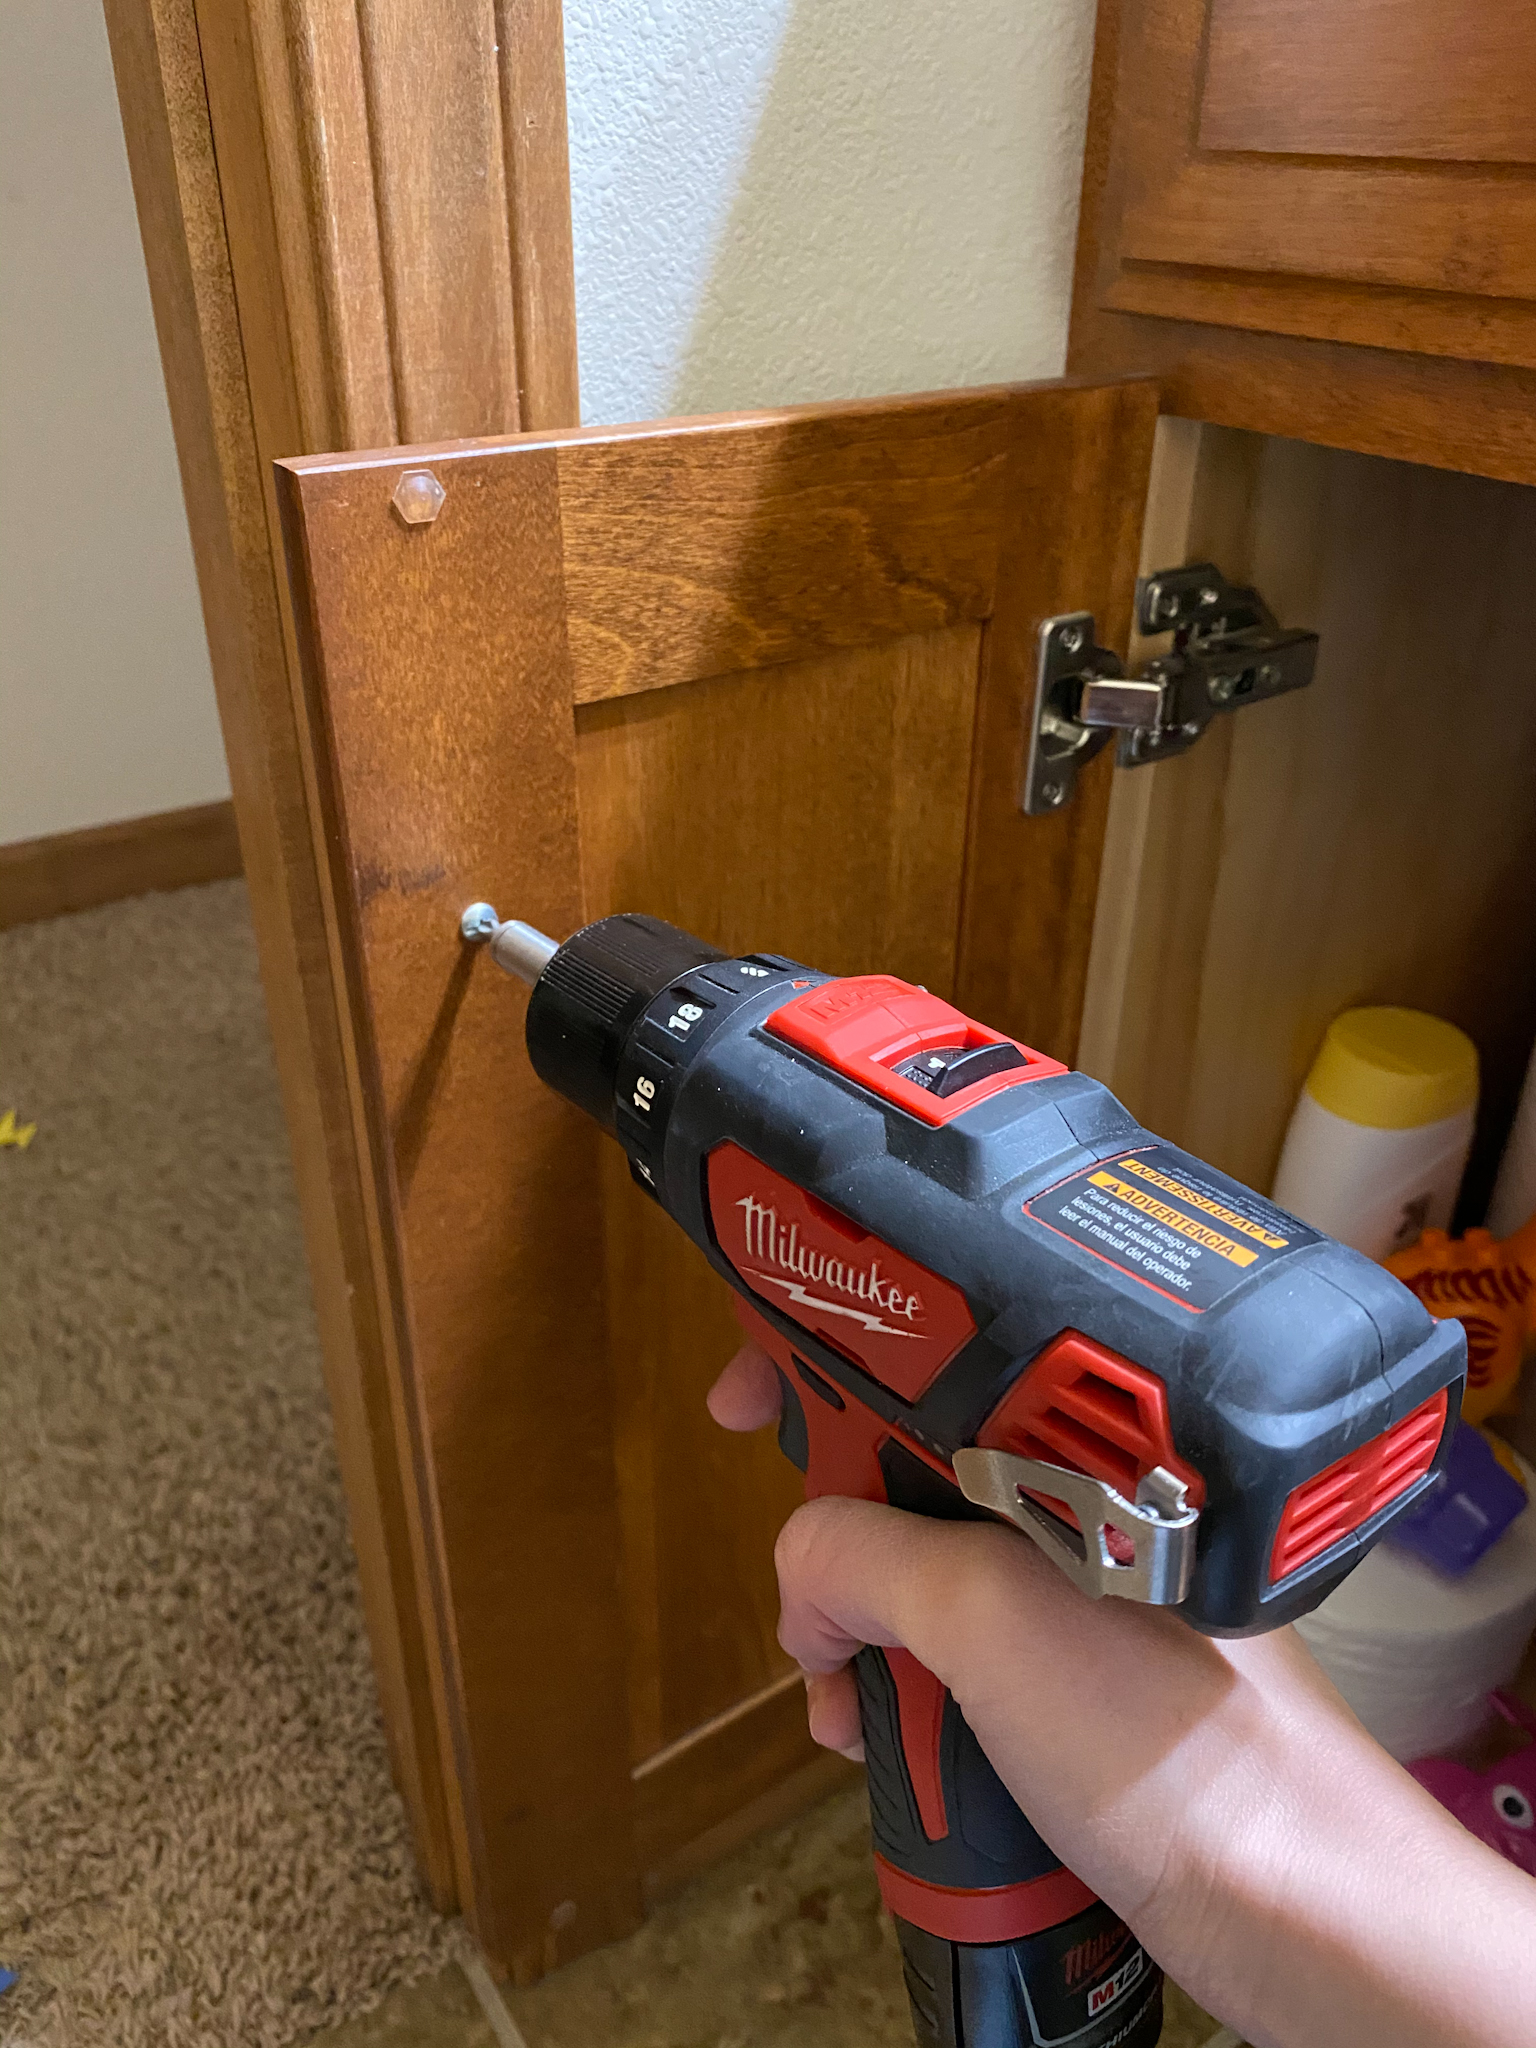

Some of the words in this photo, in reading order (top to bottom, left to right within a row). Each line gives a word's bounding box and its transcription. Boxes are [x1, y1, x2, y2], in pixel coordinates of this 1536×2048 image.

[669, 1003, 703, 1031] 18
[633, 1076, 655, 1112] 16
[1083, 1188, 1107, 1206] Para
[1107, 1199, 1145, 1225] reducir
[1143, 1217, 1153, 1231] el
[1152, 1224, 1185, 1249] riesgo
[1185, 1241, 1202, 1259] de
[1120, 1190, 1236, 1255] ADVERTENCIA
[1125, 1162, 1262, 1233] AVERTISSEMENT
[735, 1195, 925, 1321] Milwaukee
[1059, 1205, 1079, 1222] leer
[1078, 1215, 1089, 1229] el
[1089, 1223, 1128, 1251] manual
[1126, 1242, 1142, 1262] del
[1143, 1256, 1193, 1291] operador.
[1071, 1196, 1113, 1226] lesiones,
[1114, 1218, 1125, 1232] el
[1125, 1226, 1162, 1254] usuario
[1163, 1245, 1191, 1271] debe
[1092, 1954, 1141, 2010] M12
